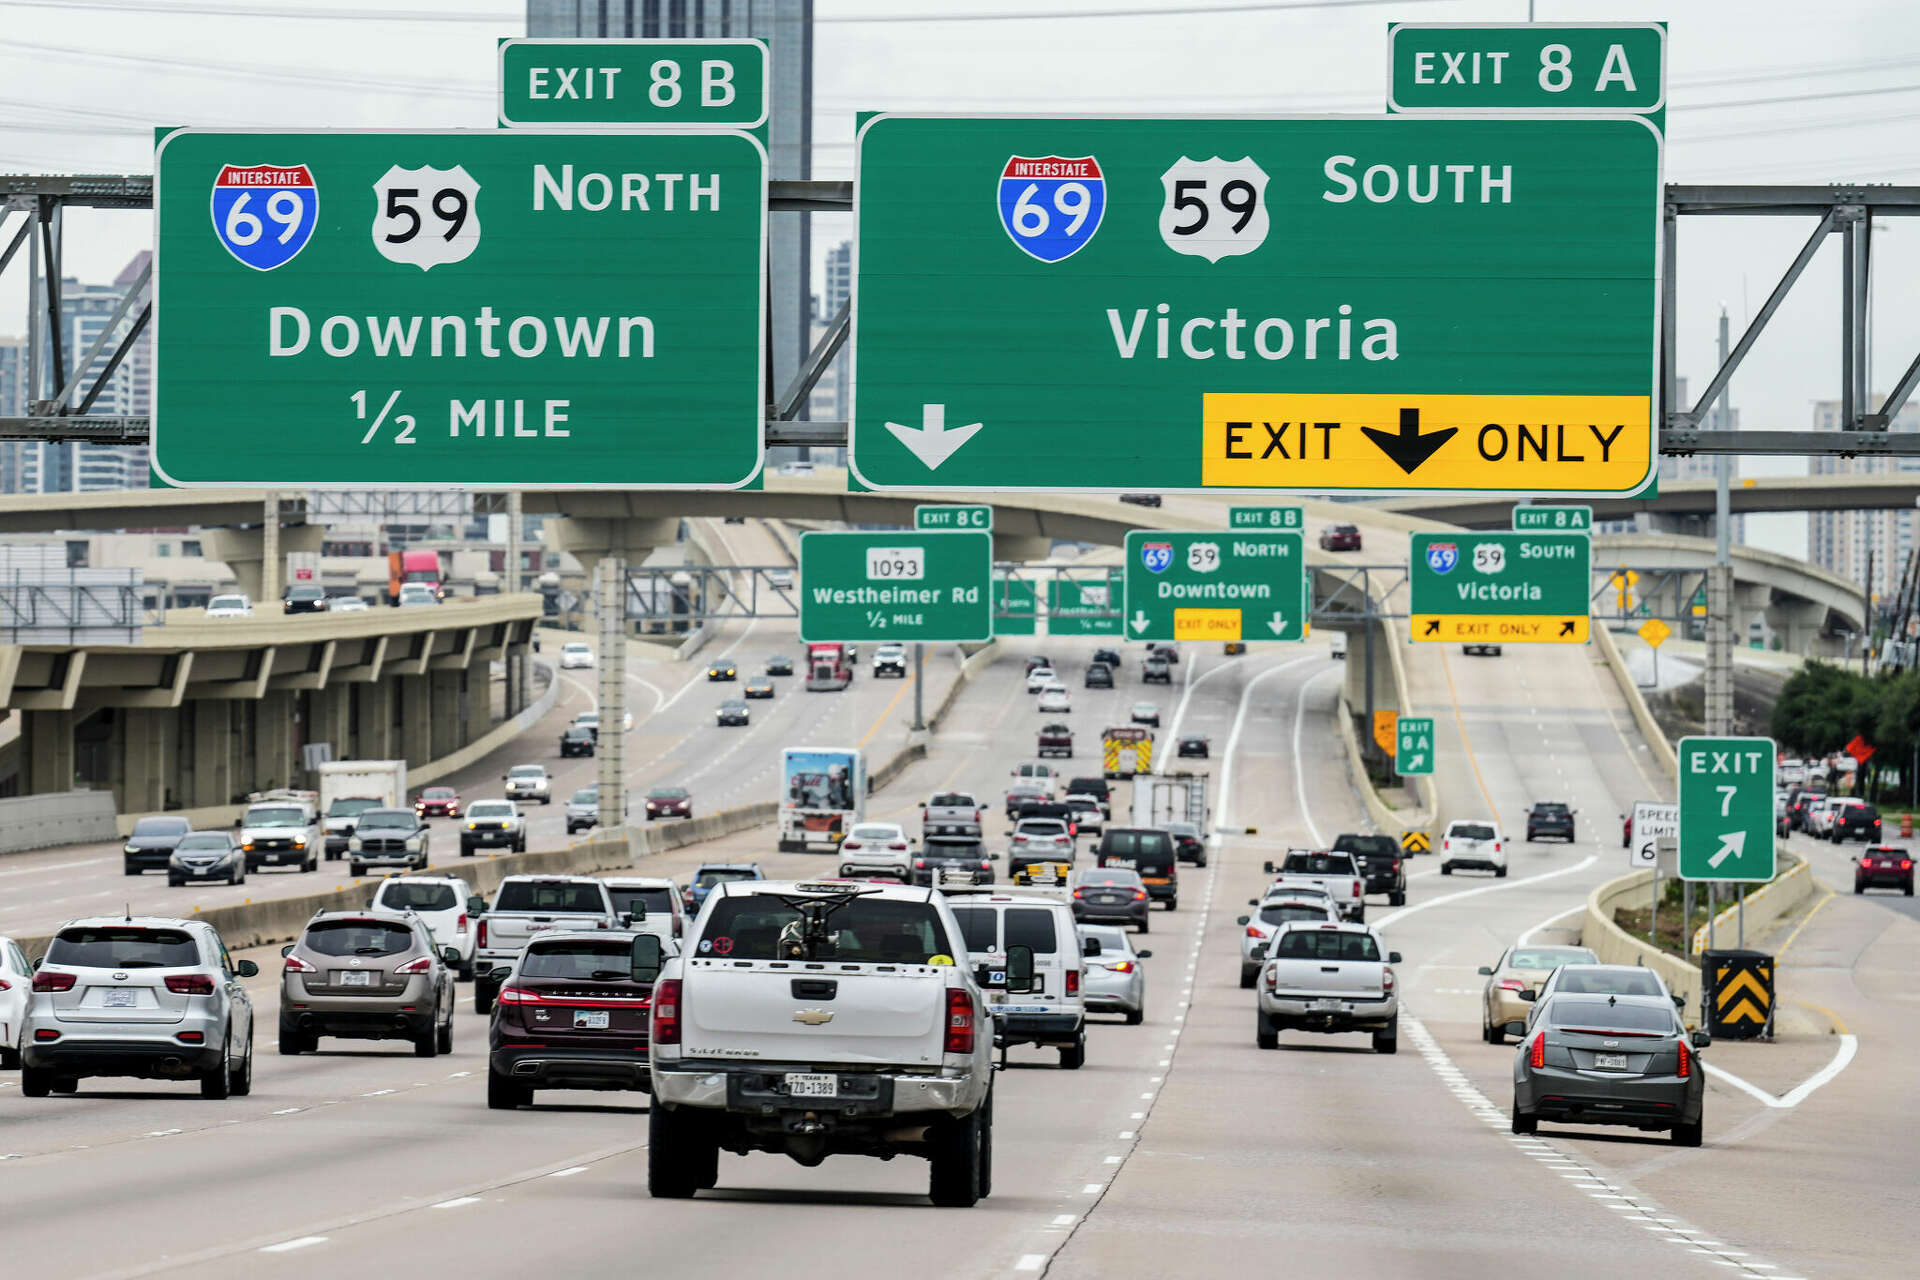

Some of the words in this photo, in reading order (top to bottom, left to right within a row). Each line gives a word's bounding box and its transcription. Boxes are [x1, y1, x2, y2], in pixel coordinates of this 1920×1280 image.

[1415, 52, 1509, 84] EXIT
[530, 68, 621, 99] EXIT
[228, 169, 301, 185] INTERSTATE
[1015, 161, 1089, 177] INTERSTATE
[1323, 155, 1512, 203] SOUTH
[534, 165, 719, 211] NORTH
[385, 188, 467, 243] 59
[1012, 182, 1090, 238] 69
[1173, 180, 1256, 235] 59
[225, 191, 304, 246] 69
[270, 307, 654, 357] Downtown
[1107, 303, 1399, 360] Victoria
[450, 400, 570, 437] MILE
[1226, 422, 1340, 459] EXIT
[1478, 424, 1624, 462] ONLY
[923, 513, 950, 524] EXIT
[1236, 512, 1262, 523] EXIT
[1520, 513, 1547, 524] EXIT
[1192, 549, 1215, 565] 59
[1233, 542, 1288, 556] NORTH
[1520, 543, 1575, 558] SOUTH
[1145, 550, 1169, 567] 69
[1430, 552, 1454, 569] 69
[1478, 551, 1501, 566] 59
[874, 560, 917, 576] 1093
[813, 587, 941, 604] Westheimer
[952, 587, 978, 603] Rd
[1159, 582, 1270, 598] Downtown
[1458, 582, 1541, 600] Victoria
[893, 614, 922, 625] MILE
[1177, 619, 1201, 629] EXIT
[1208, 620, 1237, 629] ONLY
[1456, 624, 1489, 635] EXIT
[1500, 624, 1539, 635] ONLY
[1401, 722, 1429, 732] EXIT
[1692, 752, 1762, 773] EXIT
[1716, 786, 1737, 816] 7
[1642, 825, 1675, 836] LIMIT
